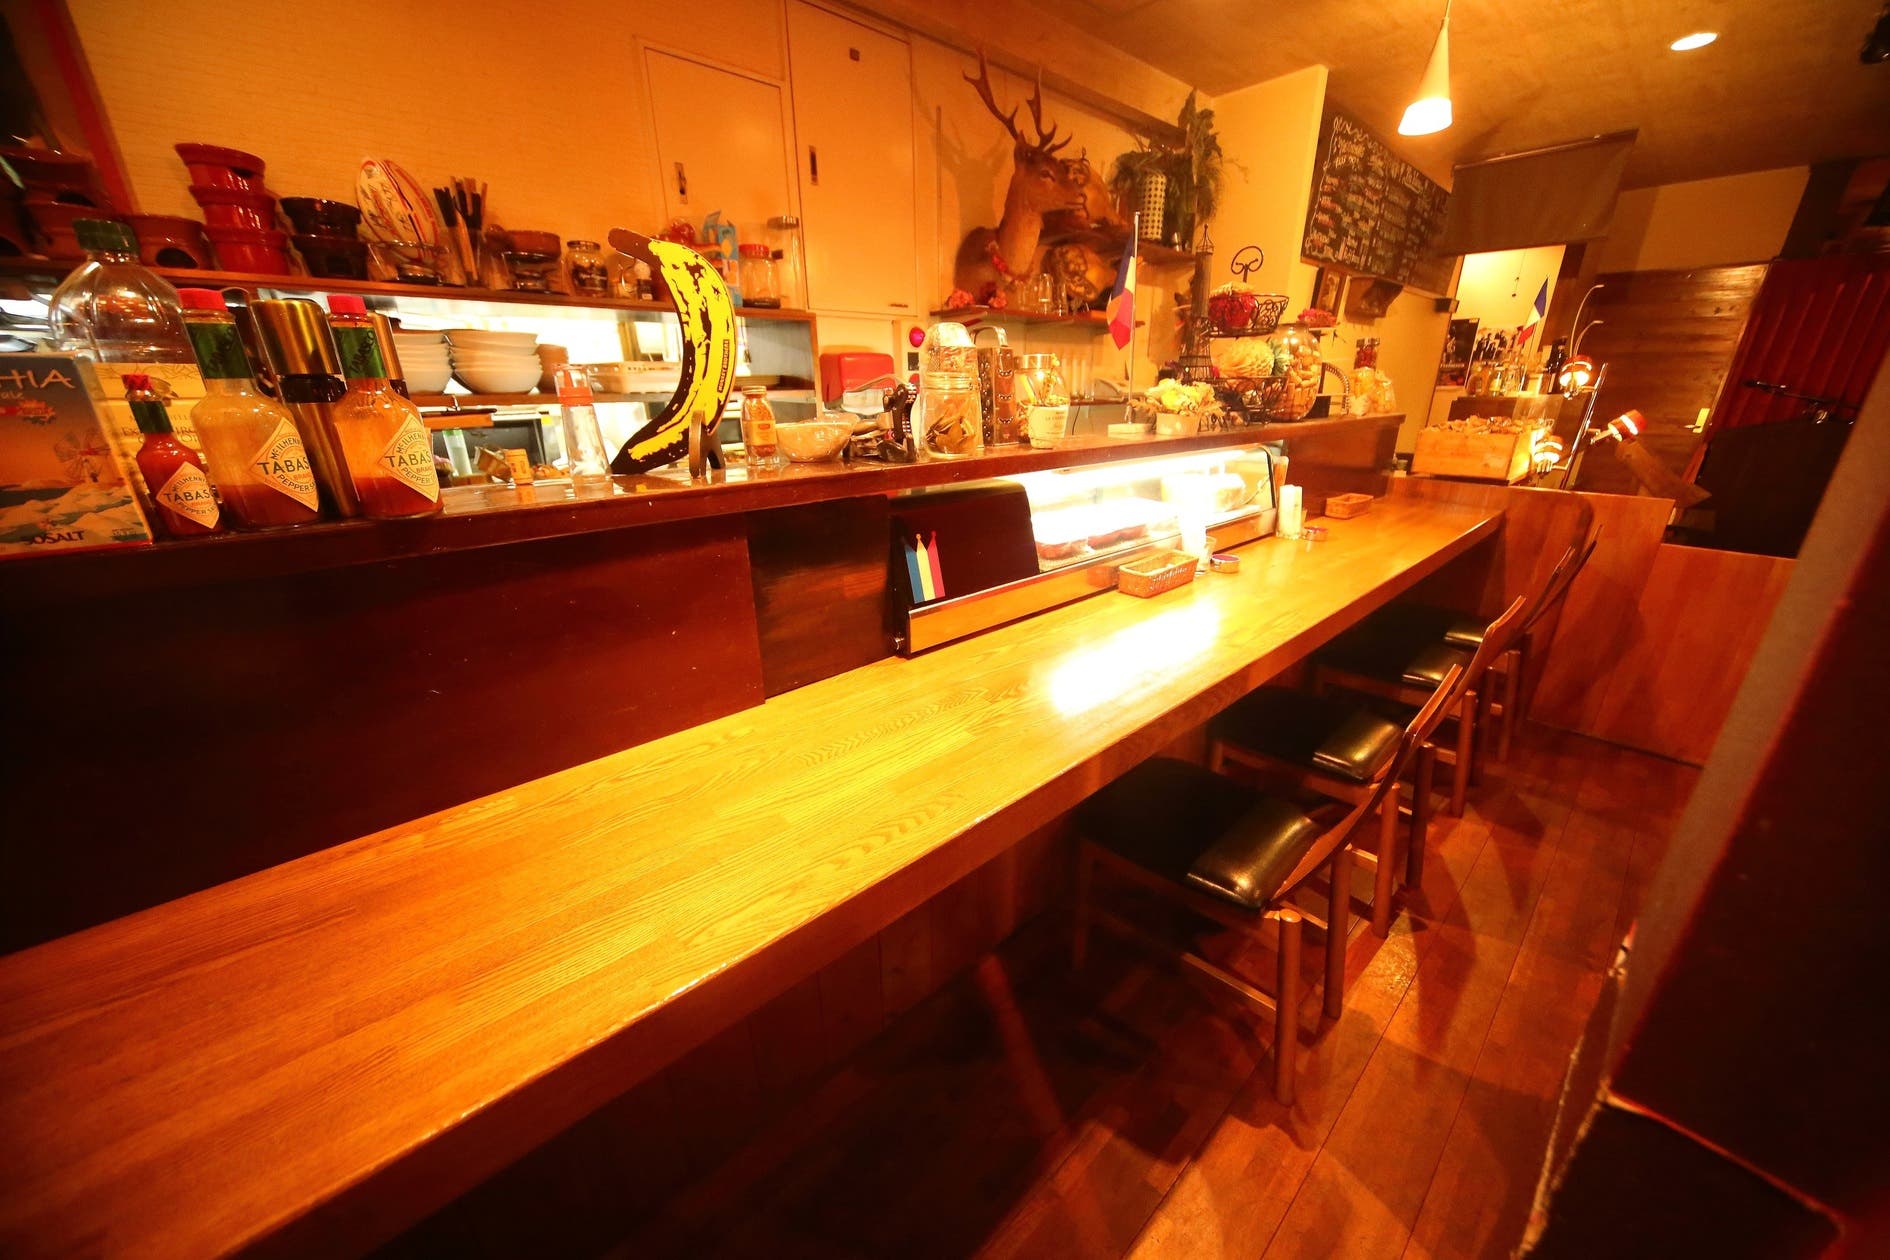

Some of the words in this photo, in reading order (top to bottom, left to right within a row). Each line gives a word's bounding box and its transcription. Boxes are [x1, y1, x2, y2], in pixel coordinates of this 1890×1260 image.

[257, 456, 310, 475] TABAS
[385, 450, 432, 468] TABAS
[164, 488, 212, 504] TABAS
